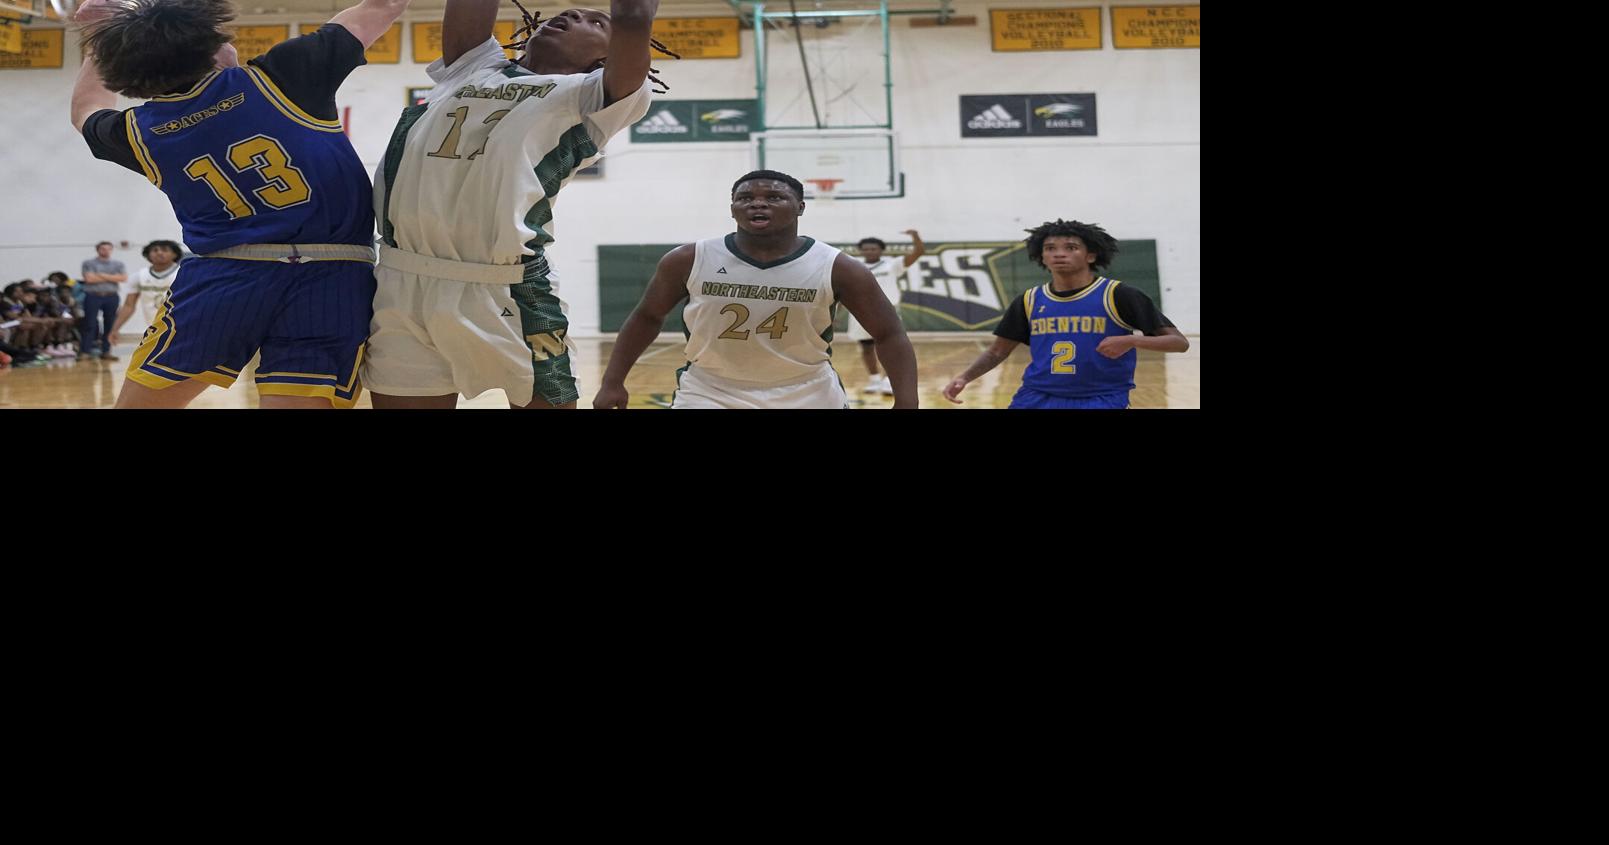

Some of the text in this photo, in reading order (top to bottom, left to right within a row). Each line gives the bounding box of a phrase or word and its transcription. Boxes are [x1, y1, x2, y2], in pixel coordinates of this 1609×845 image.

[1007, 20, 1086, 31] CHAMPIONS
[1128, 19, 1200, 28] CHAMPION
[1001, 30, 1091, 40] VOLLEYBALL
[183, 133, 312, 220] 13
[701, 281, 818, 303] NORTHEASTERN
[717, 303, 789, 341] 24
[1030, 316, 1107, 336] EDENTON
[1050, 340, 1076, 374] 2
